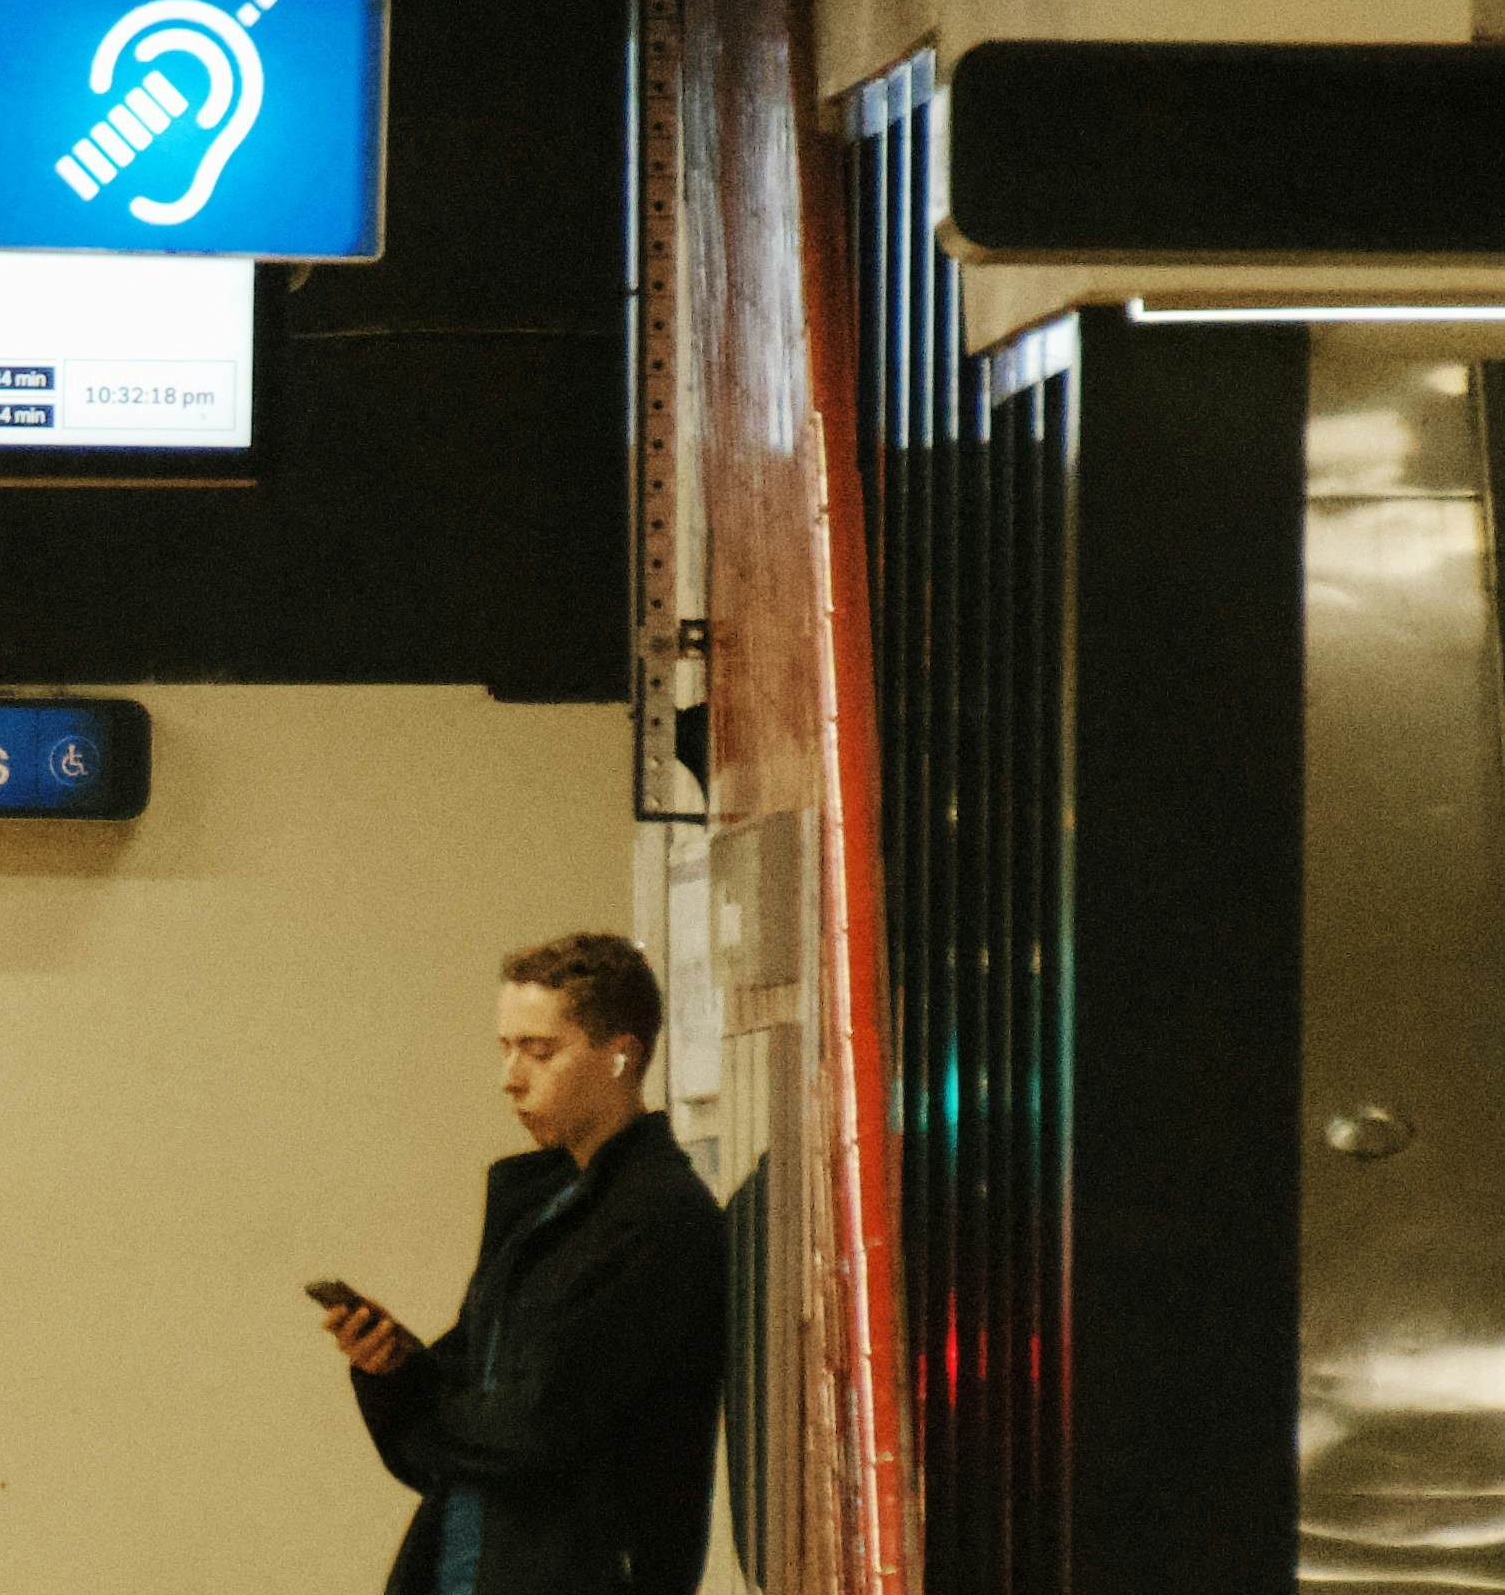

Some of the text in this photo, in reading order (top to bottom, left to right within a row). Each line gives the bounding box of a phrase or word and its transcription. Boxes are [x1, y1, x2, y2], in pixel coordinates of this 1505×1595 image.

[15, 370, 47, 389] min
[85, 386, 216, 410] 10:32:18 pm
[14, 407, 46, 426] min
